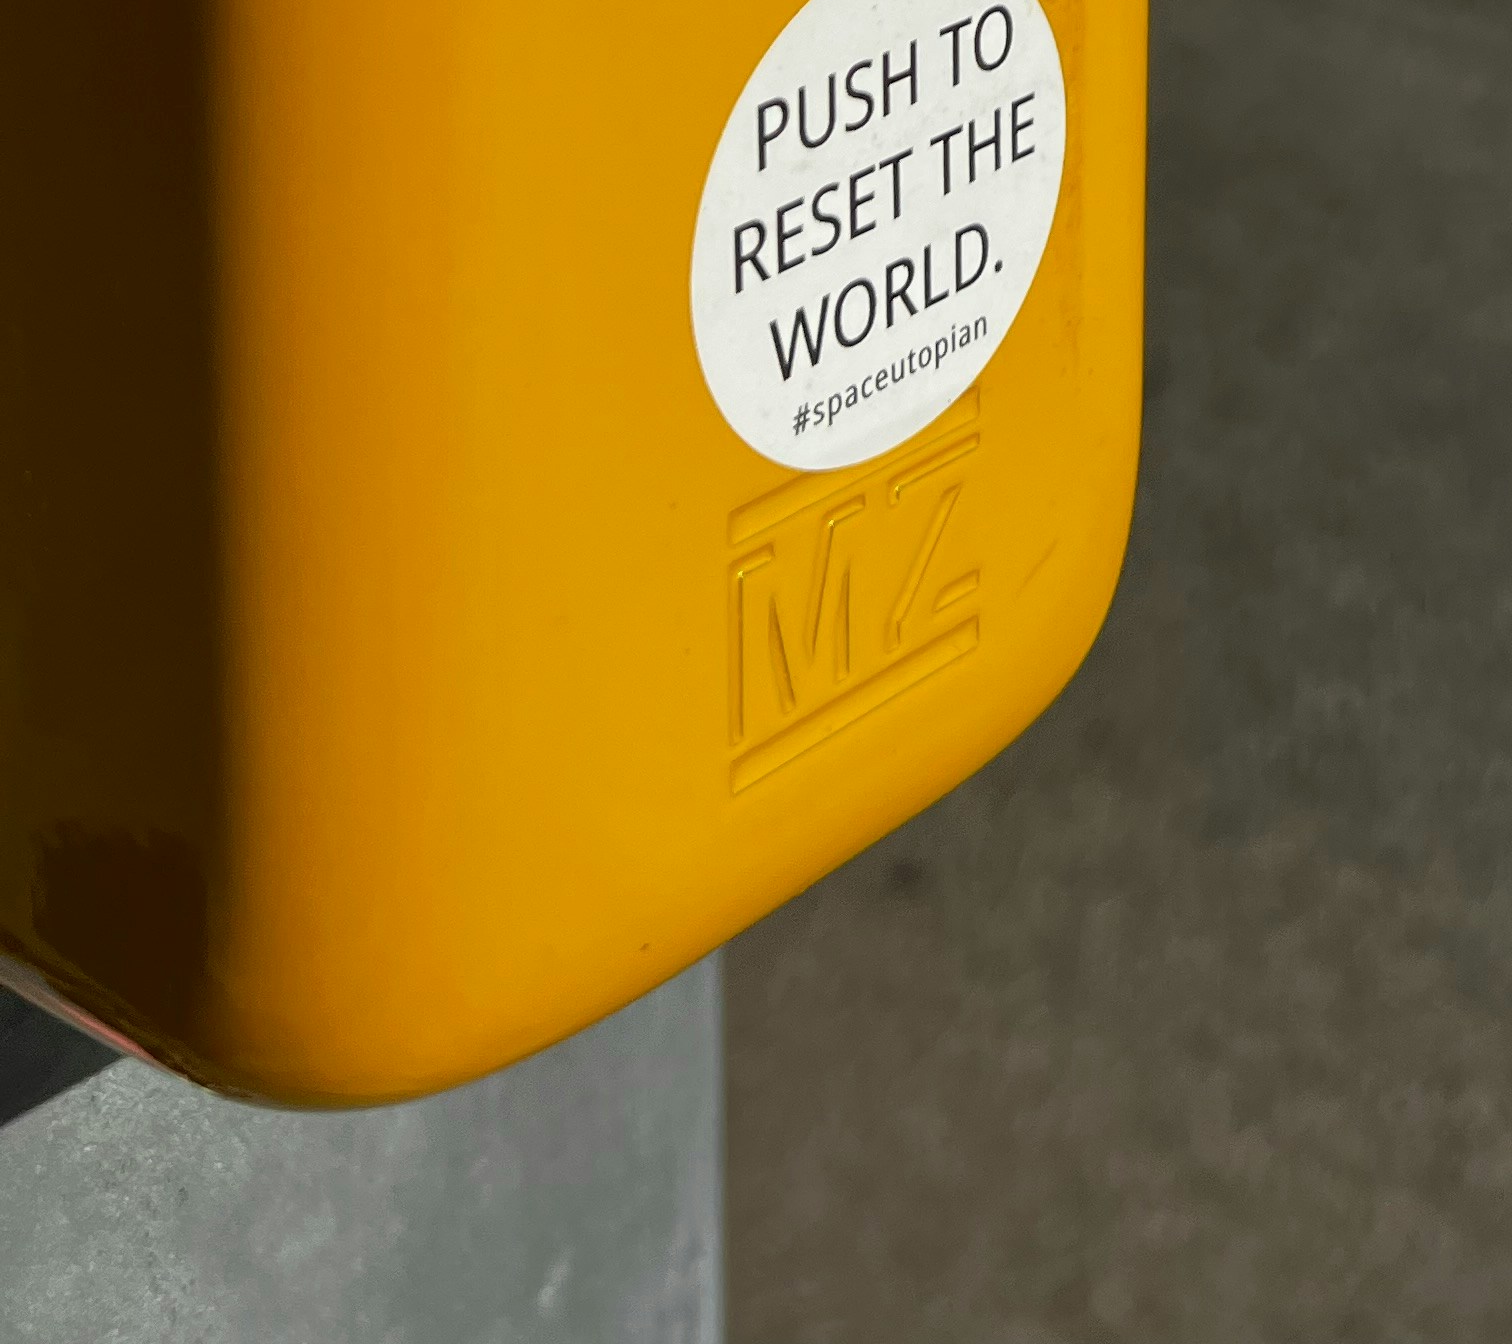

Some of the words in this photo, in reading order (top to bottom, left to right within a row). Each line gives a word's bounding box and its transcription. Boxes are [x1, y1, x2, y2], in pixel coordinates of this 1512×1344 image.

[756, 38, 919, 172] PUSH
[939, 4, 1014, 87] TO
[733, 147, 913, 294] RESET
[929, 93, 1036, 197] THE
[769, 222, 1003, 382] WORLD.
[792, 316, 988, 435] #spaceutopian
